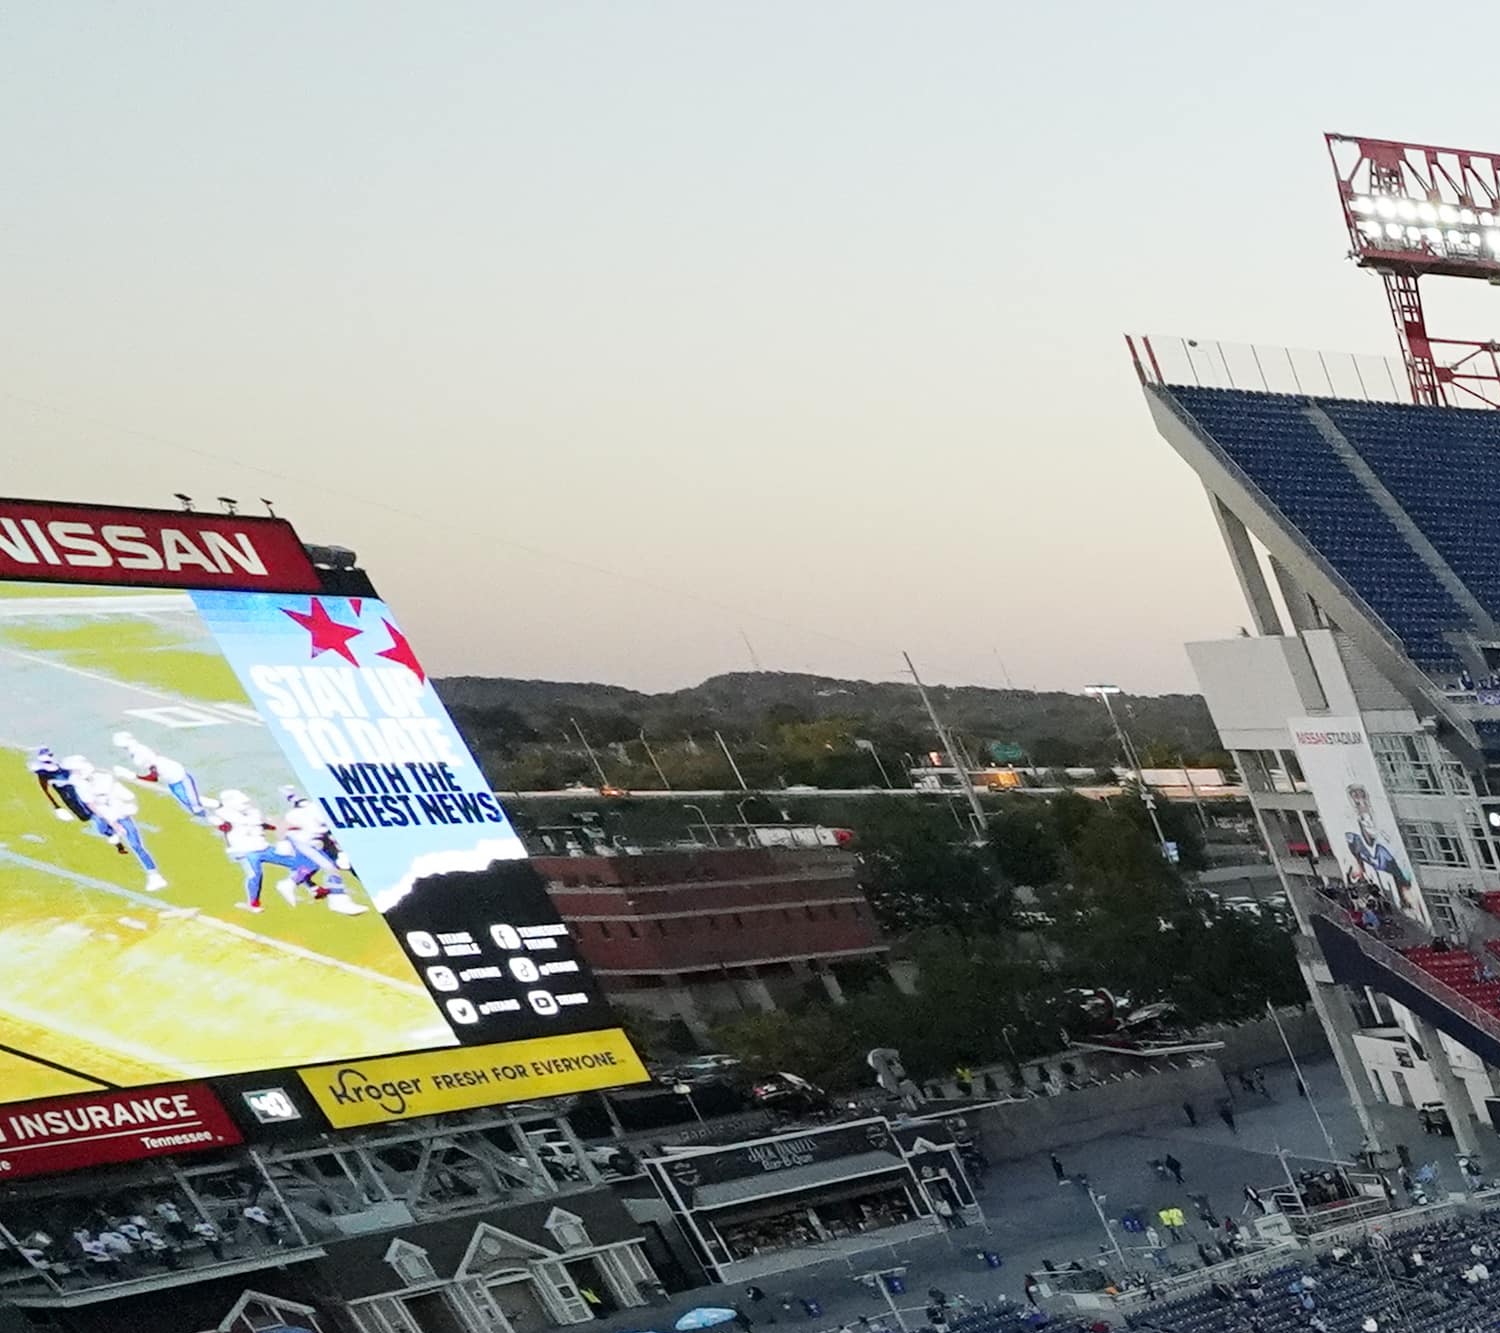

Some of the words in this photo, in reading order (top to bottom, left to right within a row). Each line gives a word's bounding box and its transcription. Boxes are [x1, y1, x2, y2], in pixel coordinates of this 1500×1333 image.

[249, 665, 361, 719] STAY
[366, 665, 427, 719] UP
[279, 718, 347, 769] TO
[349, 718, 462, 769] DATE
[327, 763, 400, 796] WITH
[402, 762, 462, 793] THE
[319, 797, 420, 830] LATEST
[424, 792, 504, 826] NEWS
[330, 1069, 421, 1114] Kroger
[433, 1071, 489, 1091] FRESH
[492, 1062, 530, 1083] FOR
[533, 1051, 617, 1077] EVERYONE
[10, 1094, 197, 1138] INSURANCE
[140, 1130, 212, 1151] Tennessee
